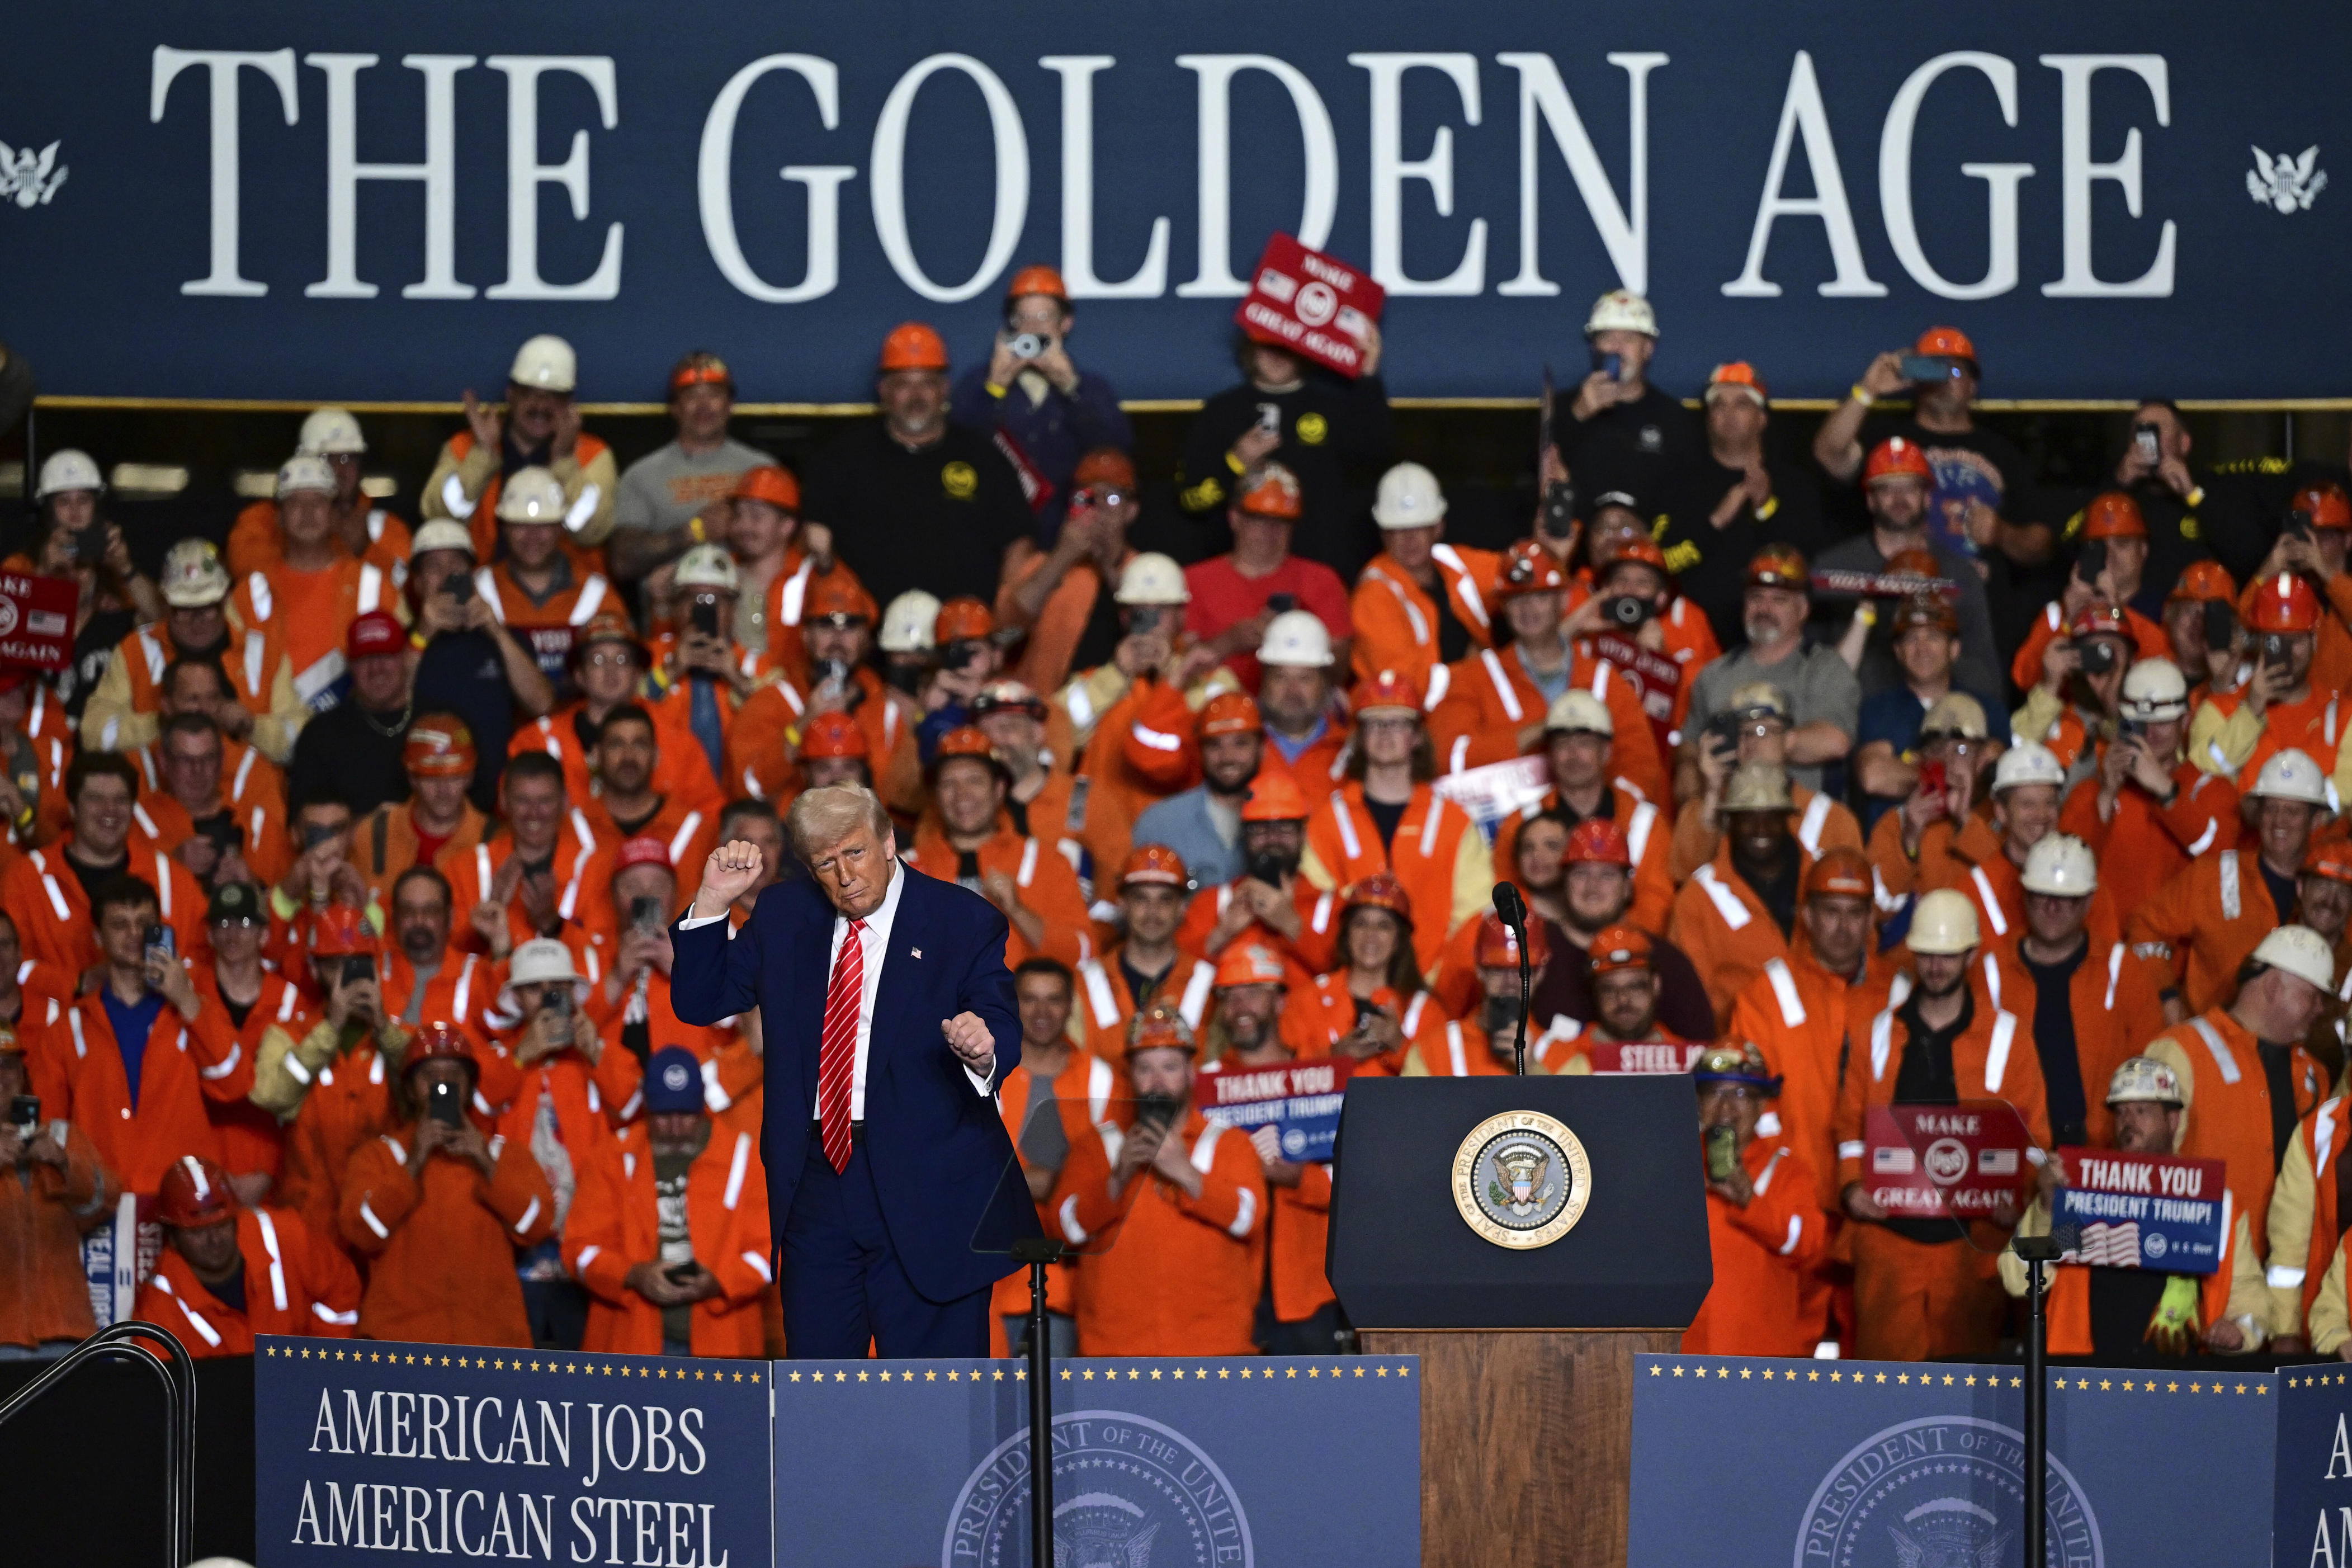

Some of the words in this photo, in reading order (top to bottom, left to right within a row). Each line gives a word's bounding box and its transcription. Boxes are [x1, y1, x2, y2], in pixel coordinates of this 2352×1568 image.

[150, 44, 624, 300] THE
[697, 52, 1670, 304] GOLDEN
[1721, 49, 2176, 301] AGE
[1245, 301, 1307, 342] GREAT
[1300, 331, 1357, 367] AGAIN
[0, 575, 32, 598] KE
[1, 641, 62, 663] AGAIN
[1620, 1044, 1682, 1072] STEEL
[1214, 1070, 1288, 1104] THANK
[1289, 1065, 1334, 1095] YOU
[1288, 1093, 1343, 1119] TRUMP
[1520, 1117, 1534, 1126] OF
[1537, 1120, 1553, 1133] THE
[1915, 1113, 1981, 1136] MAKE
[1457, 1116, 1517, 1177] PRESIDENT
[1556, 1132, 1585, 1187] UNITED
[1458, 1181, 1470, 1201] THE
[2079, 1158, 2153, 1194] THANK
[2159, 1165, 2202, 1197] YOU
[1464, 1203, 1475, 1215] OF
[1873, 1186, 1947, 1208] GREAT
[1950, 1187, 2014, 1208] AGAIN
[2064, 1189, 2150, 1220] PRESIDENT
[2153, 1198, 2213, 1225] TRUMP!
[1475, 1213, 1509, 1241] SEAL
[1534, 1199, 1580, 1241] STATES
[309, 1387, 574, 1467] AMERICAN
[582, 1402, 706, 1487] JOBS
[954, 1421, 1091, 1558] PRESIDNT
[1103, 1427, 1132, 1444] OF
[1137, 1433, 1178, 1465] THE
[1181, 1459, 1241, 1568] UNITE
[1806, 1427, 1948, 1557] PRESIDENT
[1959, 1432, 1989, 1451] OF
[291, 1479, 556, 1561] AMERICAN
[570, 1496, 728, 1568] STEEL
